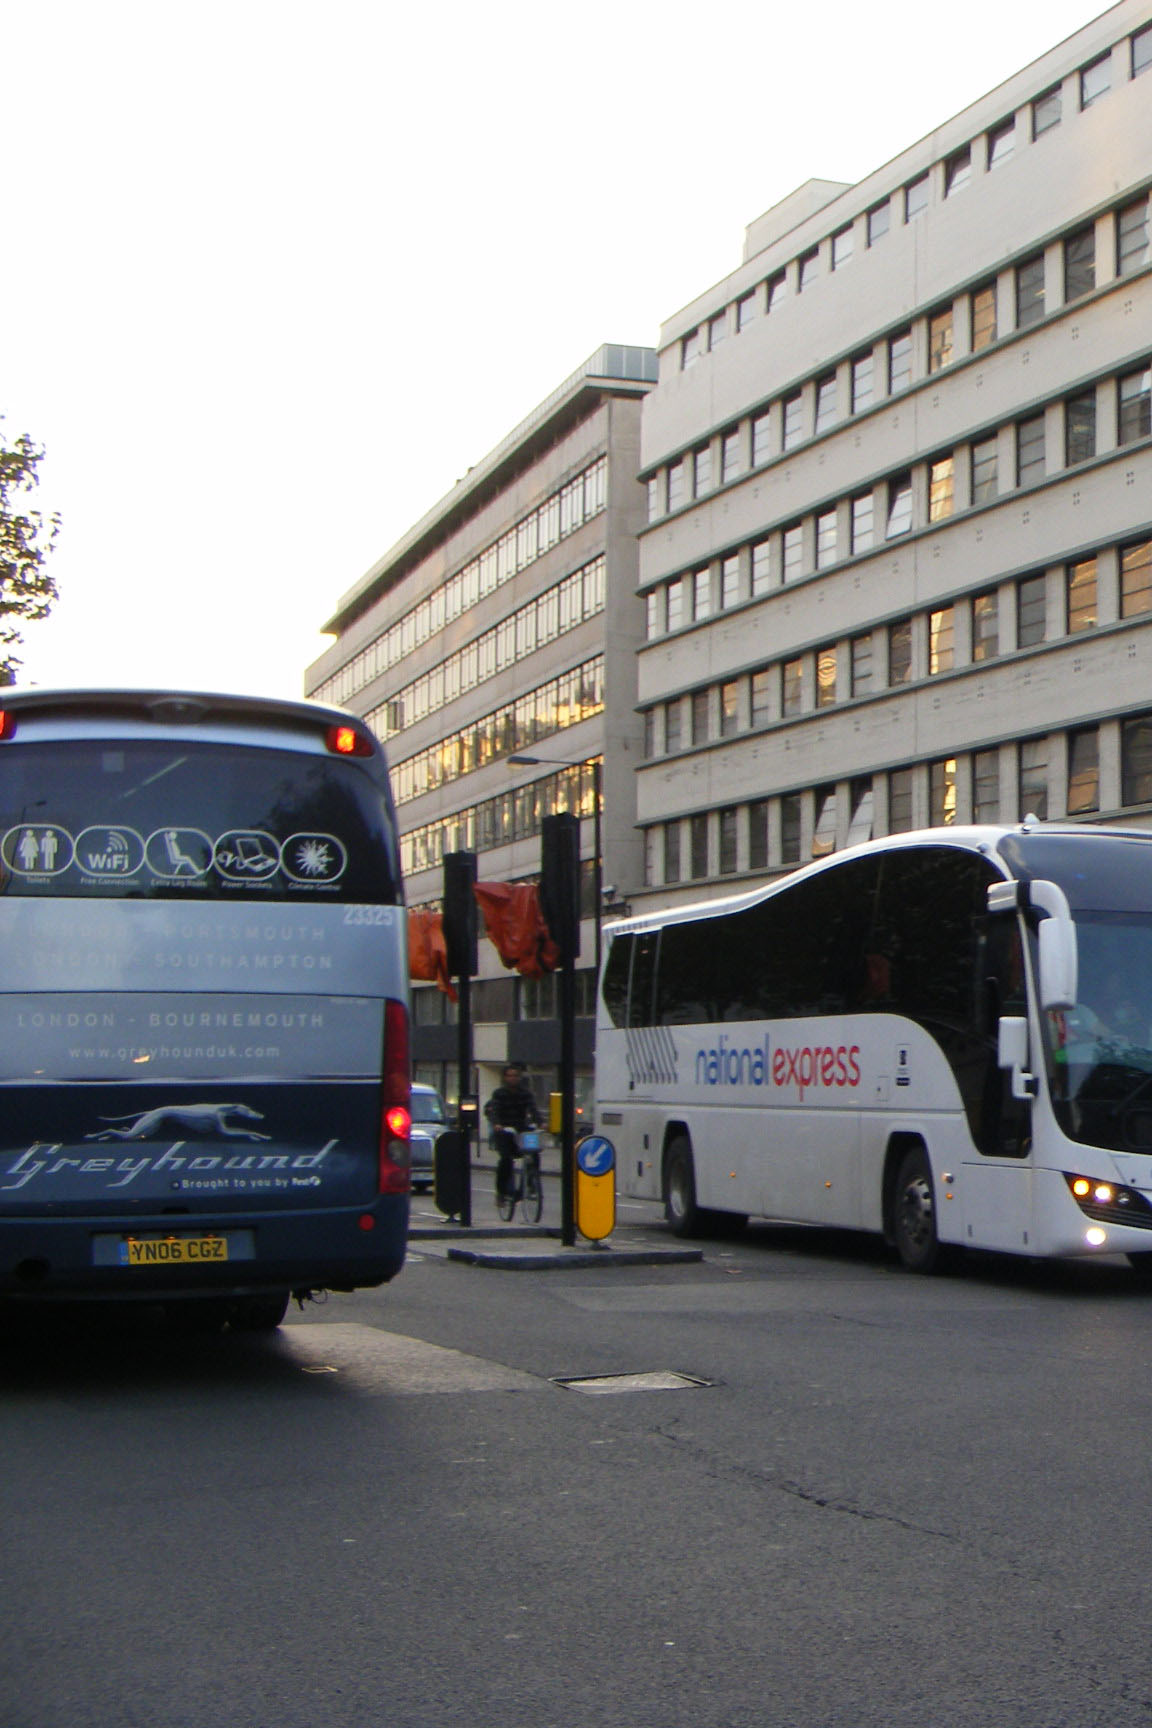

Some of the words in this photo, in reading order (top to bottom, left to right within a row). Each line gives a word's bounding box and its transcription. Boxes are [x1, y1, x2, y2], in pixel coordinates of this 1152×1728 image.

[343, 905, 393, 926] 23325
[163, 923, 326, 941] PORTSMOUTH
[154, 952, 333, 969] SOUTHAMPTON
[17, 1013, 115, 1028] LONDON
[149, 1012, 325, 1028] BOURNEMOUTH
[69, 1043, 280, 1062] www.greyhounduk.com
[695, 1033, 770, 1086] national
[773, 1045, 861, 1103] express
[182, 1178, 230, 1190] Brought
[233, 1178, 246, 1188] to
[250, 1179, 271, 1189] you
[275, 1177, 289, 1189] by
[132, 1242, 182, 1261] YN06
[187, 1240, 225, 1259] CGZ
